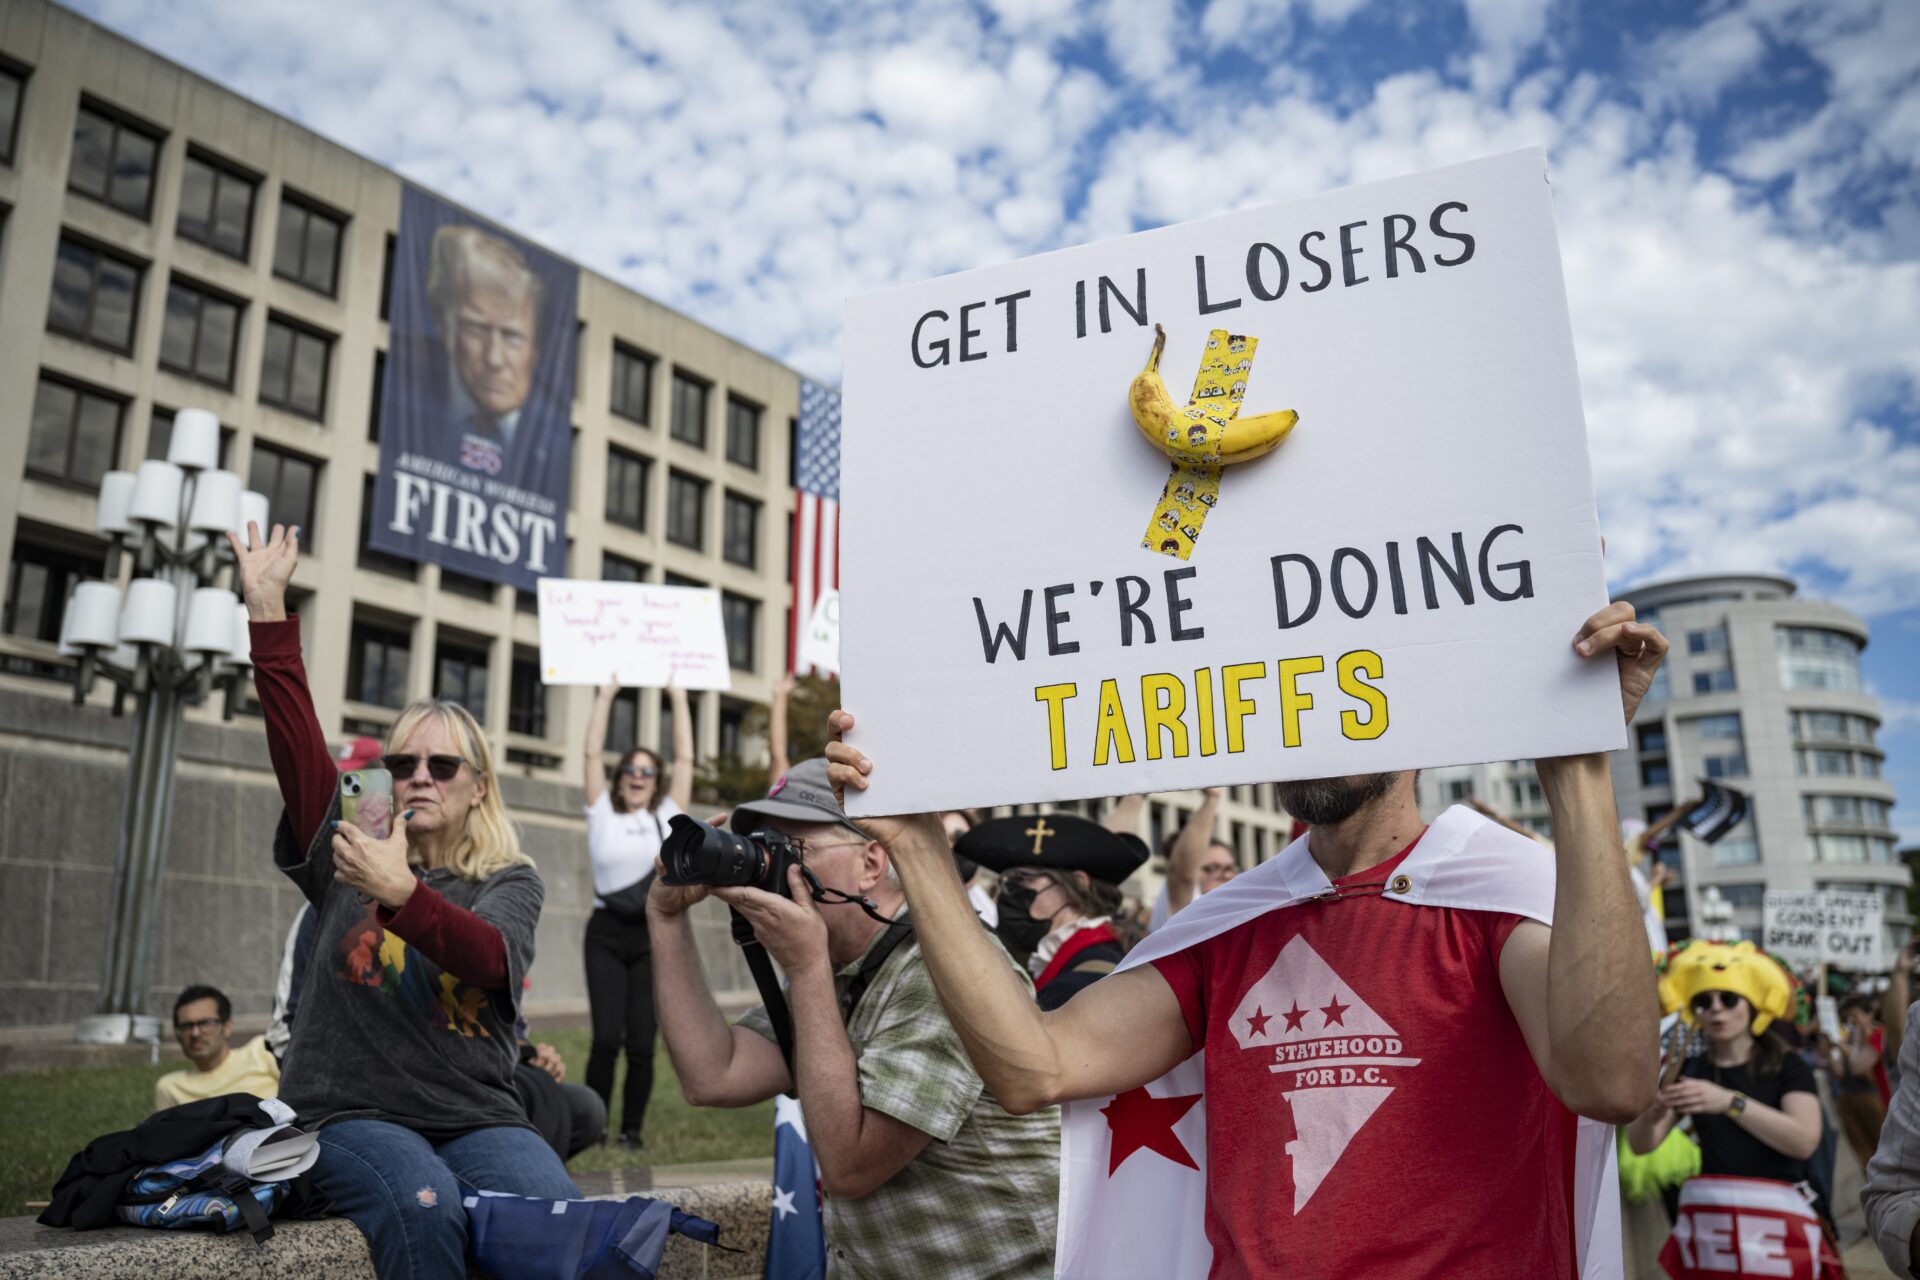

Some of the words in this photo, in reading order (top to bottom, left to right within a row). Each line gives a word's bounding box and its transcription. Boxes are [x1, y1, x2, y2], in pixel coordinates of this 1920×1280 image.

[912, 289, 1031, 369] GET
[1075, 267, 1149, 339] IN
[1195, 201, 1476, 316] LOSERS
[388, 469, 557, 573] FIRST
[972, 566, 1205, 664] WE'RE
[1270, 523, 1535, 630] DOING
[1034, 649, 1390, 771] TARIFFS
[1827, 931, 1873, 955] OUT
[1275, 1037, 1403, 1062] STATEHOOD
[1295, 1069, 1336, 1088] FOR
[1340, 1067, 1388, 1084] D.C.
